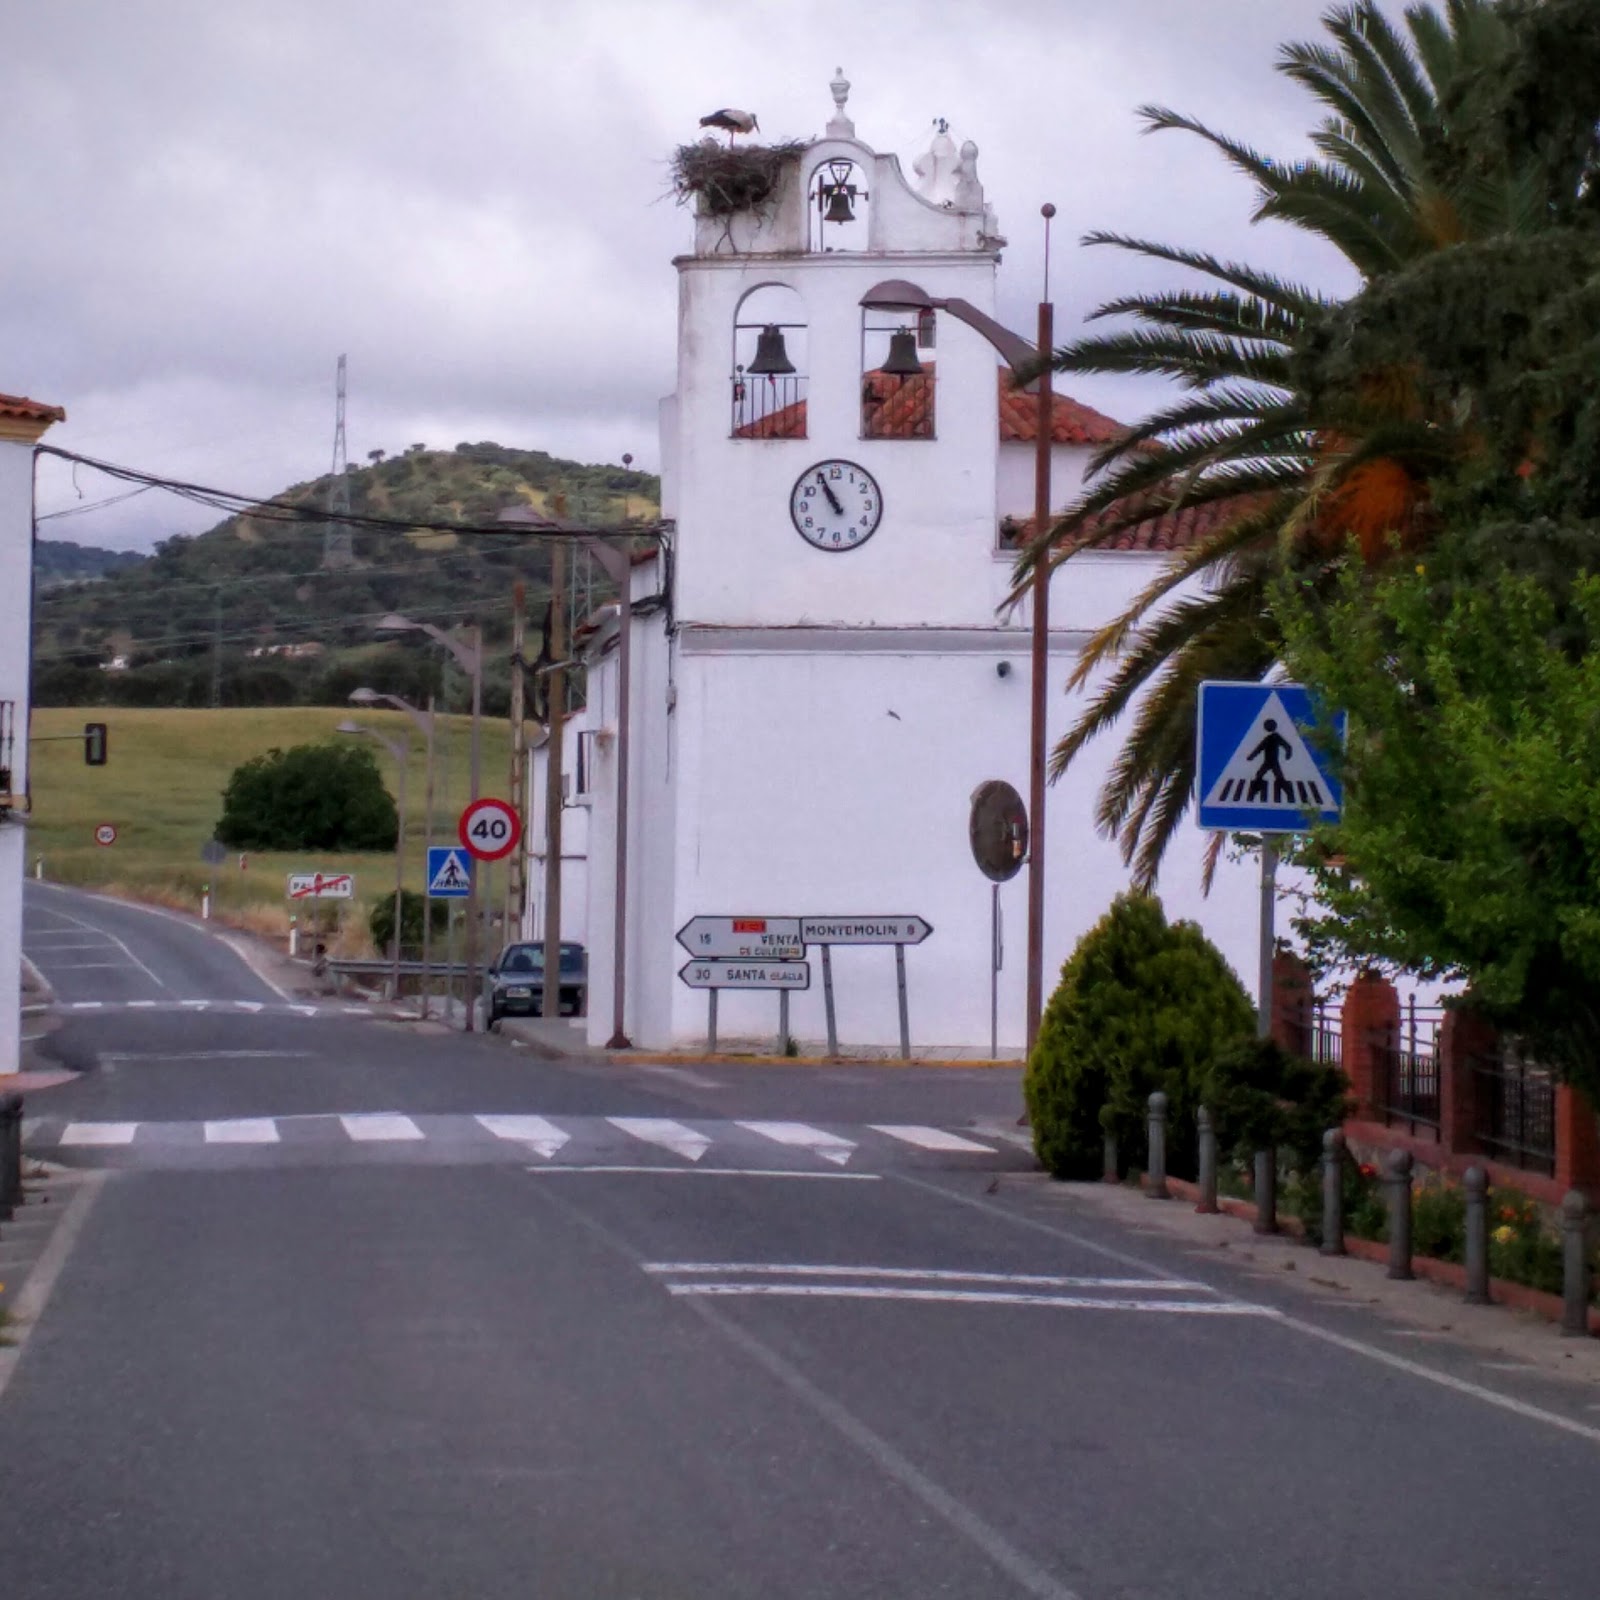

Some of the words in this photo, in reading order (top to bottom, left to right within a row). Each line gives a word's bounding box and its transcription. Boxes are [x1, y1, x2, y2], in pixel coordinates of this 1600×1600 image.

[830, 468, 842, 480] 12
[849, 472, 855, 484] 1
[803, 486, 817, 498] 10
[859, 482, 869, 495] 2
[799, 501, 809, 513] 9
[863, 499, 873, 511] 3
[804, 516, 814, 529] 8
[859, 514, 868, 527] 4
[816, 528, 827, 541] 7
[832, 531, 841, 543] 6
[848, 527, 858, 540] 5
[471, 818, 507, 840] 40
[804, 924, 899, 937] MONTEMOLIN
[761, 933, 801, 946] VENTA
[726, 968, 767, 982] SANTA
